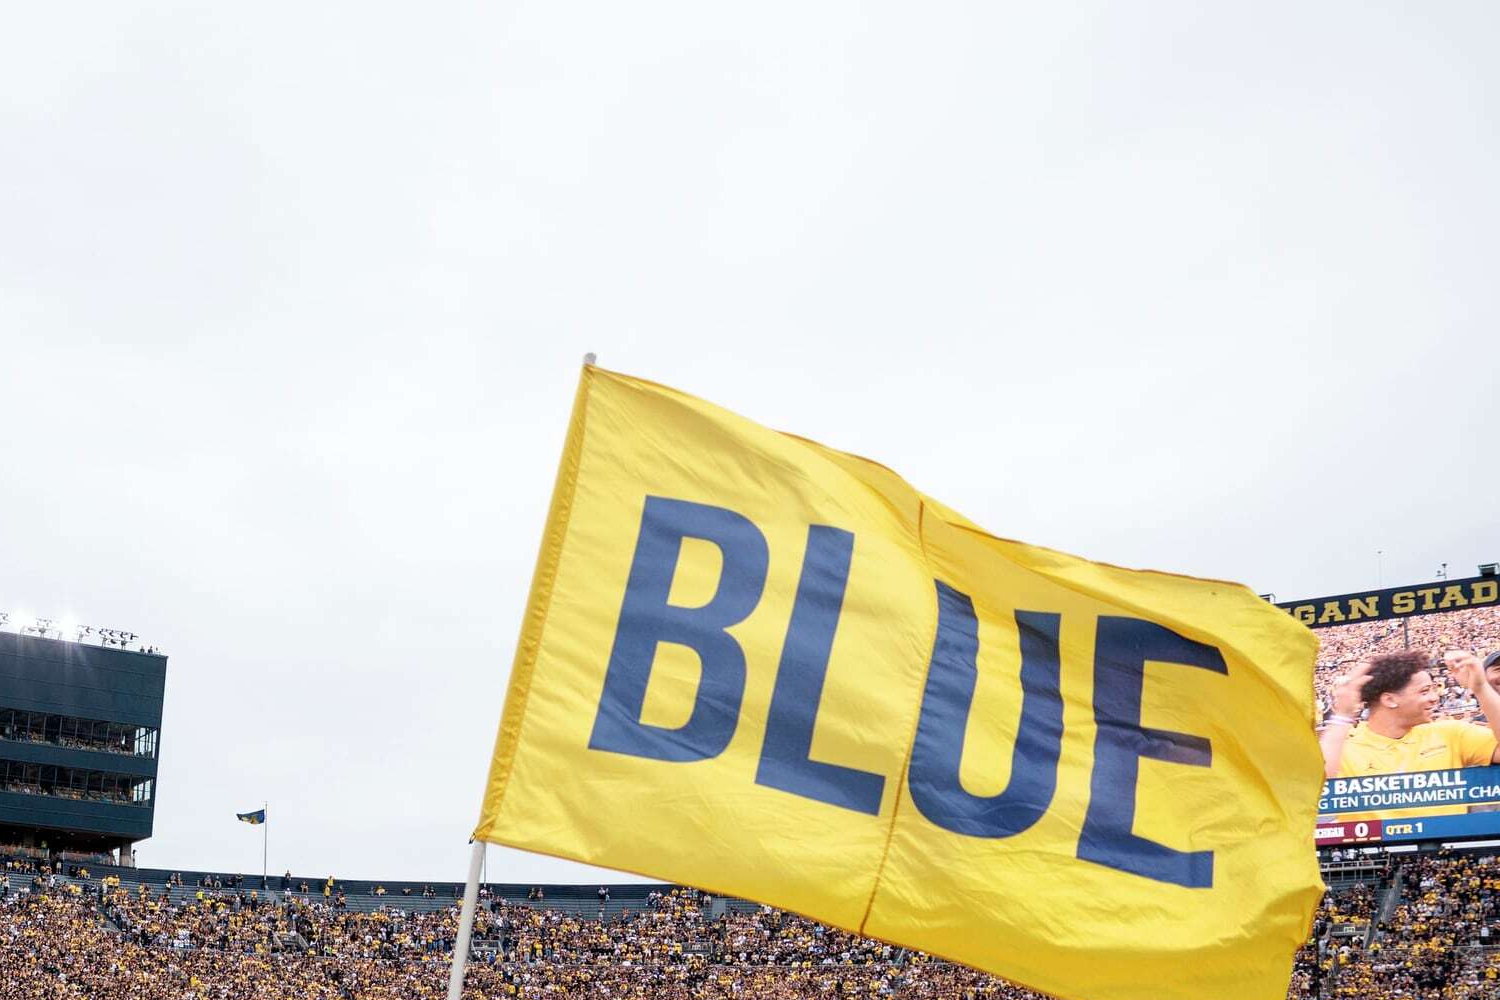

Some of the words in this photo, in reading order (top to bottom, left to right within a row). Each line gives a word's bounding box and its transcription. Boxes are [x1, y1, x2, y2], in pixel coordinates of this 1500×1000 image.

[1283, 596, 1379, 626] GAN
[1392, 580, 1498, 614] STAD
[588, 494, 1229, 889] BLUE
[1334, 770, 1467, 795] BASKETBALL
[1331, 796, 1359, 809] TEN
[1361, 787, 1467, 807] TOURNAMENT
[1354, 822, 1369, 837] 0
[1386, 824, 1412, 836] QTR
[1415, 821, 1424, 833] 1
